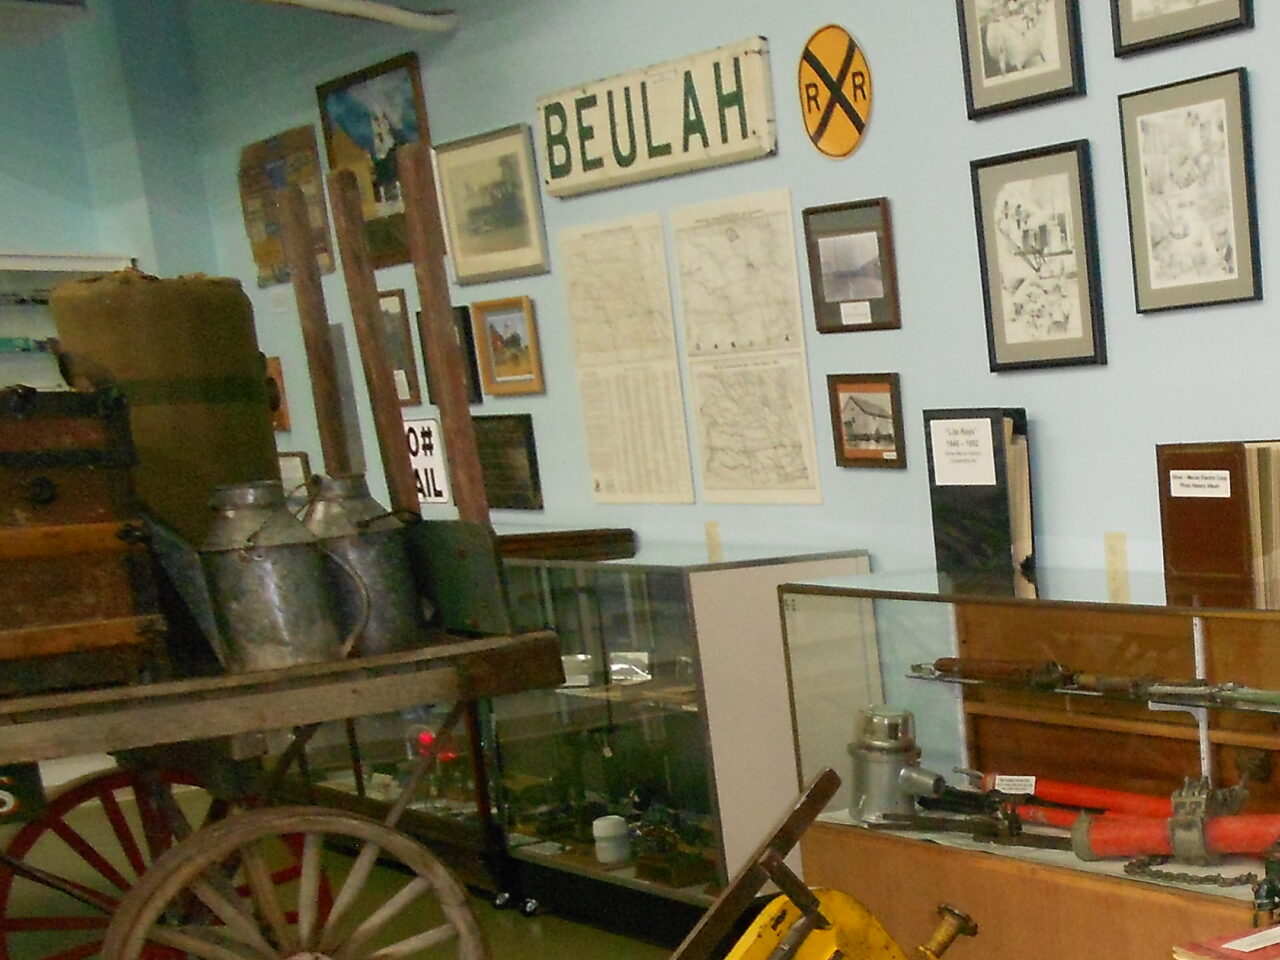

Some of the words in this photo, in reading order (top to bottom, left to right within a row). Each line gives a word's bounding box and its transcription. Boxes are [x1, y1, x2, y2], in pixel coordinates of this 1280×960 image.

[544, 57, 749, 180] BEULAH
[805, 83, 821, 114] R
[852, 71, 866, 102] R
